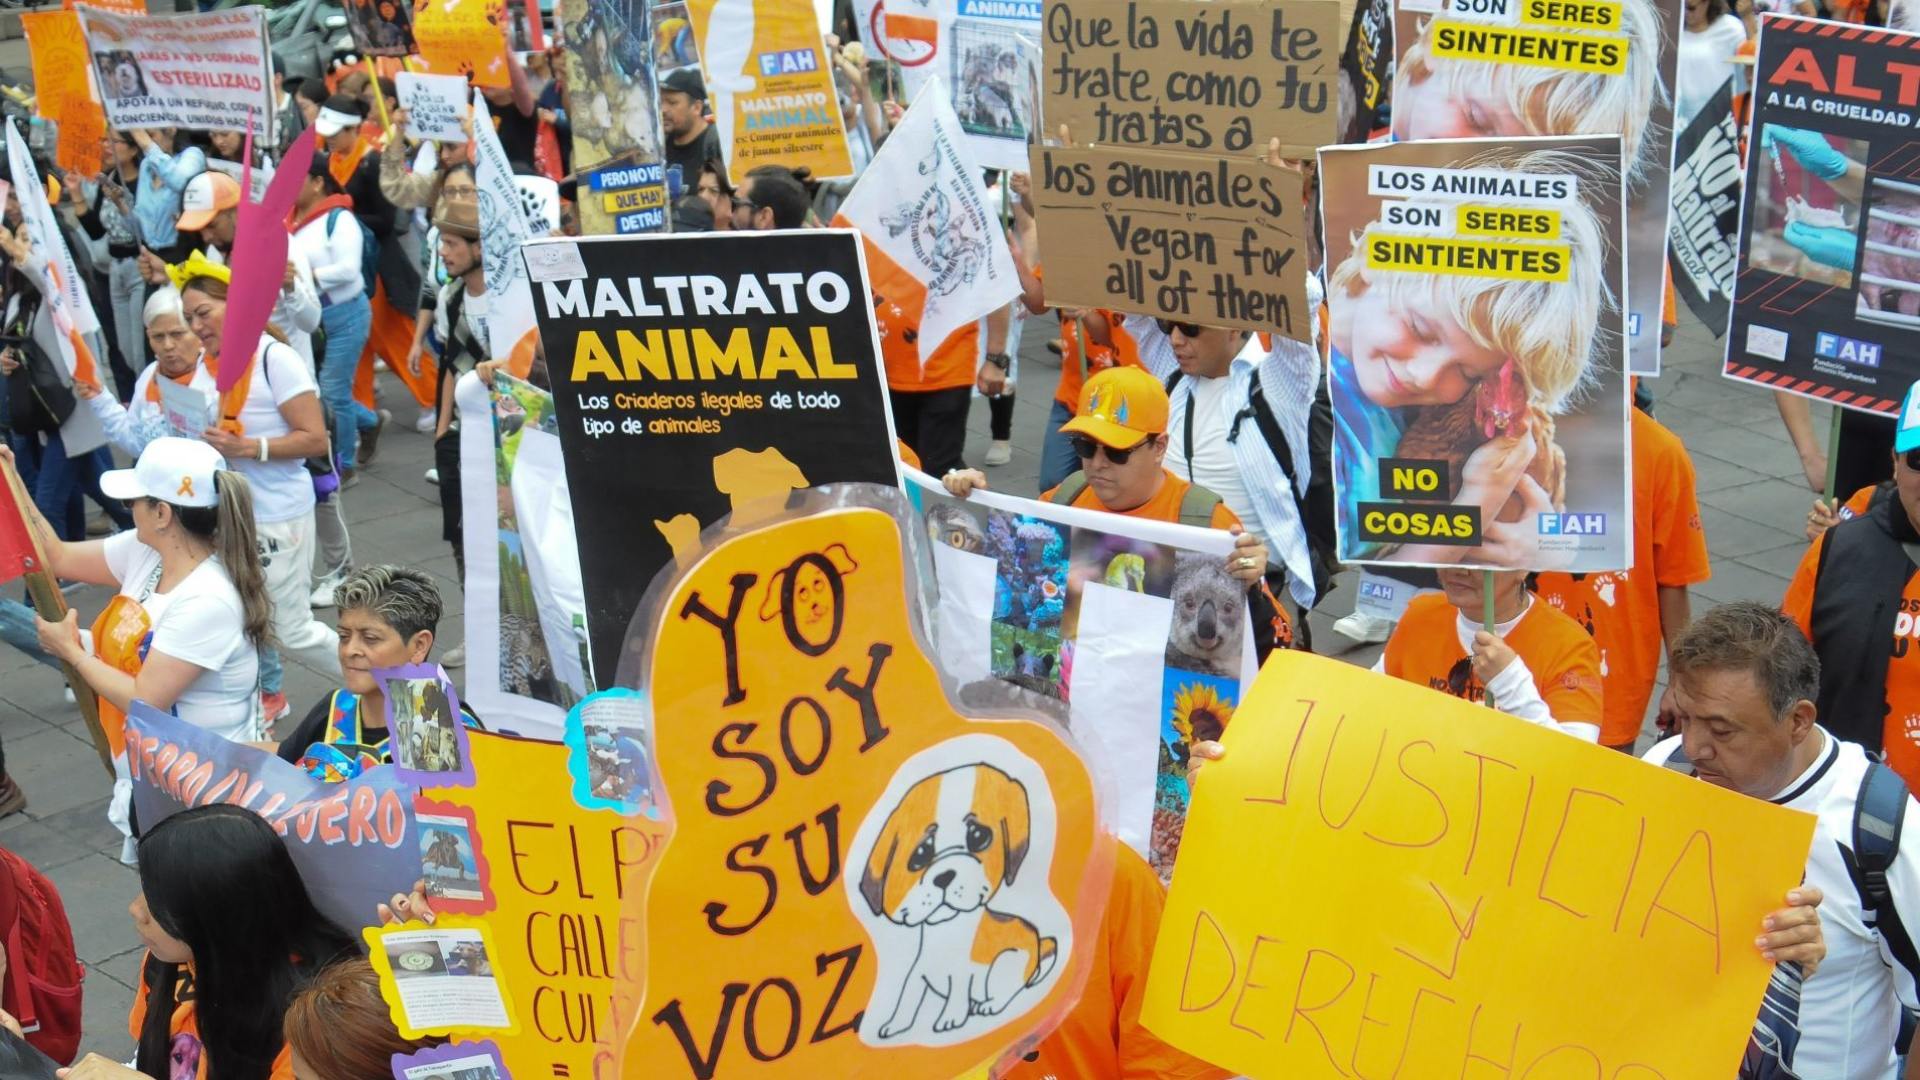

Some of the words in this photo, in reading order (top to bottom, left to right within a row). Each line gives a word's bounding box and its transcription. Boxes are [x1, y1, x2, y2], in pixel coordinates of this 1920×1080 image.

[965, 1, 1041, 17] ANIMAL
[1530, 0, 1613, 25] SERES
[1048, 2, 1119, 54] Que
[1128, 1, 1159, 50] la
[1176, 10, 1253, 60] vida
[1271, 8, 1322, 61] te
[1437, 28, 1620, 66] SINTIENTES
[760, 50, 815, 75] FAH
[741, 92, 826, 112] MALTRATO
[1166, 69, 1260, 108] como
[1277, 64, 1328, 113] tú
[746, 107, 832, 131] ANIMAL
[1094, 102, 1212, 149] tratas
[1224, 116, 1253, 151] a
[1767, 91, 1779, 105] A
[1784, 94, 1807, 110] LA
[1811, 99, 1911, 127] CRUELDAD
[600, 170, 629, 188] PERO
[1043, 151, 1095, 195] los
[1107, 160, 1282, 217] animales
[1377, 171, 1425, 191] LOS
[1431, 174, 1568, 199] ANIMALES
[616, 192, 640, 209] QUE
[1388, 206, 1441, 228] SON
[1465, 210, 1550, 234] SERES
[1105, 213, 1216, 281] Vegan
[1234, 227, 1295, 277] for
[1372, 240, 1562, 274] SINTIENTES
[542, 270, 850, 318] MALTRATO
[1106, 259, 1145, 304] all
[1157, 270, 1197, 314] of
[1208, 273, 1292, 334] them
[570, 326, 858, 382] ANIMAL
[1820, 334, 1878, 365] FAH
[578, 394, 609, 410] Los
[615, 392, 696, 410] Criaderos
[701, 391, 763, 417] ilegales
[770, 391, 792, 409] de
[798, 391, 840, 409] todo
[583, 417, 614, 439] tipo
[621, 417, 643, 434] de
[648, 417, 721, 434] animales
[1392, 468, 1439, 492] NO
[1364, 511, 1473, 537] COSAS
[1541, 514, 1603, 534] FAH
[680, 551, 846, 706] YO
[704, 643, 892, 817] SOY
[1245, 699, 1720, 975] JUSTICIA
[703, 804, 840, 936] SU
[1394, 881, 1483, 980] Y
[652, 943, 866, 1080] VOZ
